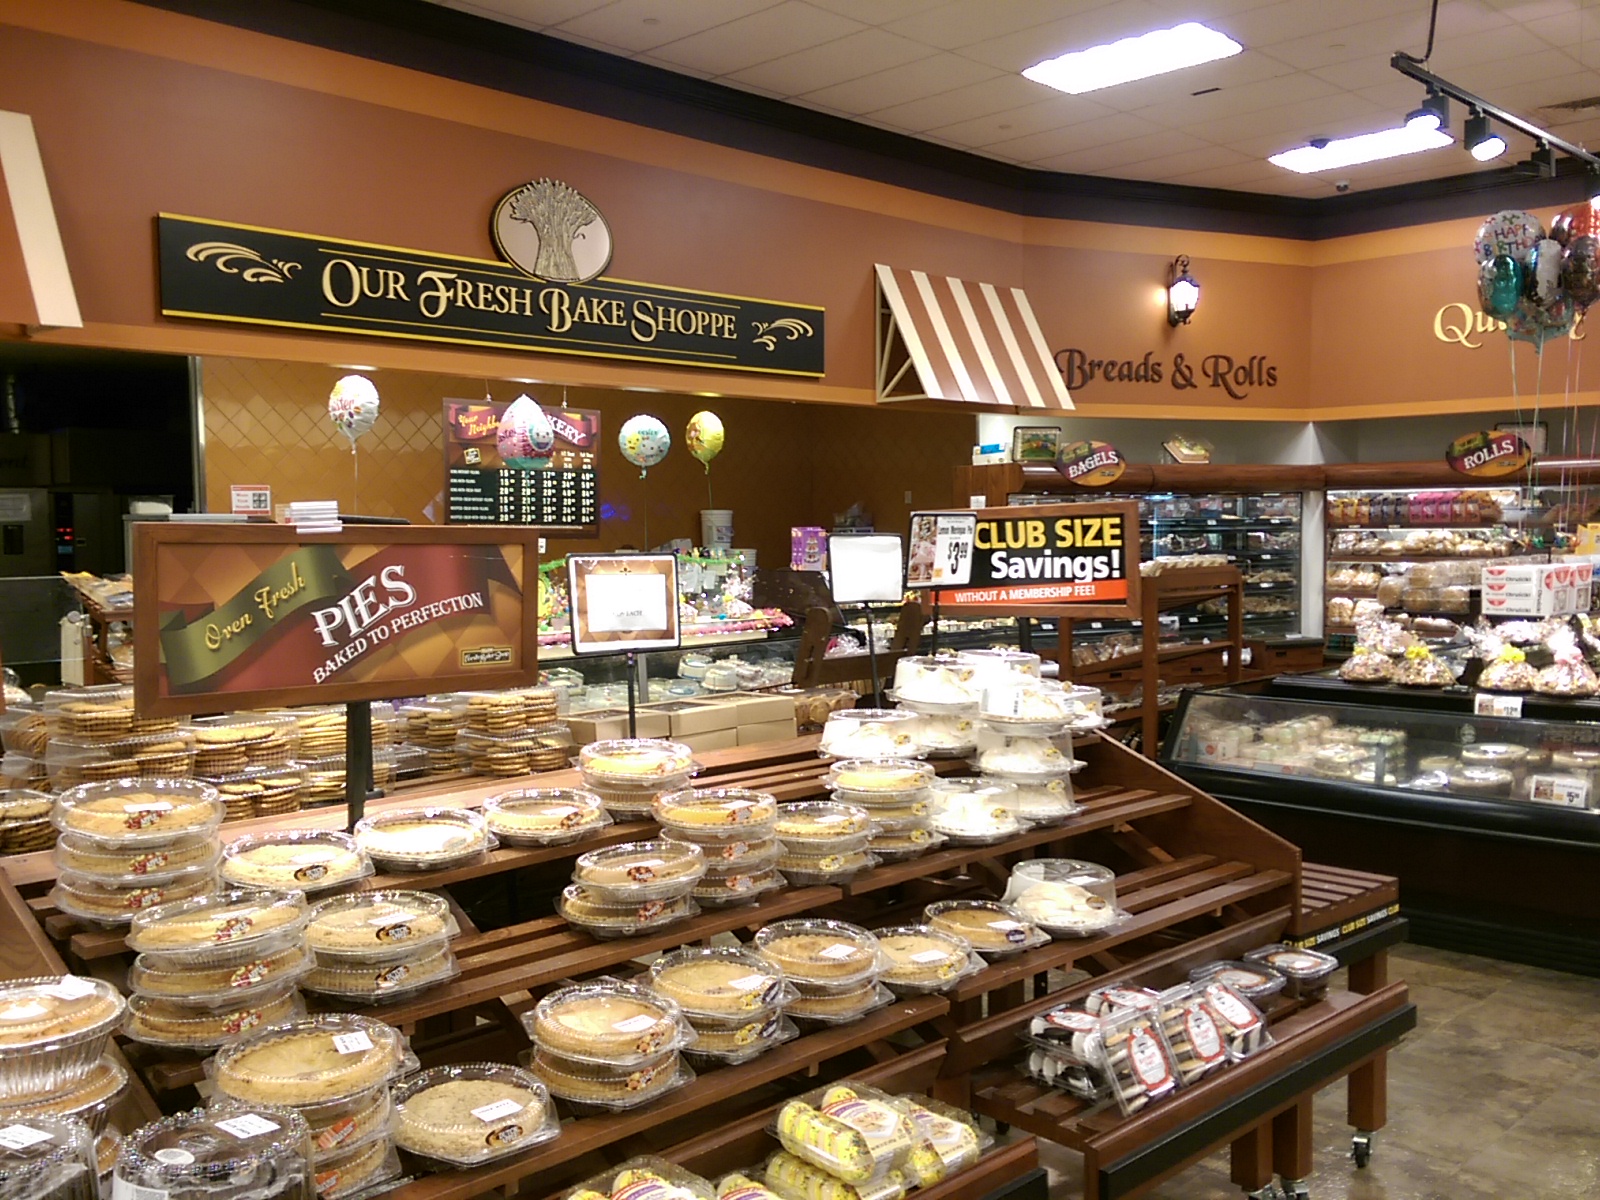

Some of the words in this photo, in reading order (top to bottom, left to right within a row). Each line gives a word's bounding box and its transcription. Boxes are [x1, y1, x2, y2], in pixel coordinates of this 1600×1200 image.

[1054, 348, 1163, 391] Breads
[1171, 353, 1198, 390] &
[1201, 354, 1278, 400] Rolls
[546, 414, 586, 444] KERY
[1069, 451, 1119, 478] BAGELS
[1464, 440, 1514, 469] ROLLS
[974, 520, 1046, 549] CLUB
[1055, 517, 1122, 548] SIZE
[990, 549, 1121, 583] Savings!
[205, 613, 253, 650] Oven
[254, 561, 306, 619] Fresh
[310, 565, 417, 647] PIES
[954, 590, 998, 603] WITHOUT
[1000, 590, 1008, 600] A
[1009, 587, 1072, 600] MEMBERSHIP
[1074, 585, 1096, 596] FEE!
[312, 637, 368, 685] BAKED
[366, 624, 391, 646] TO
[390, 592, 485, 634] PERFECTION
